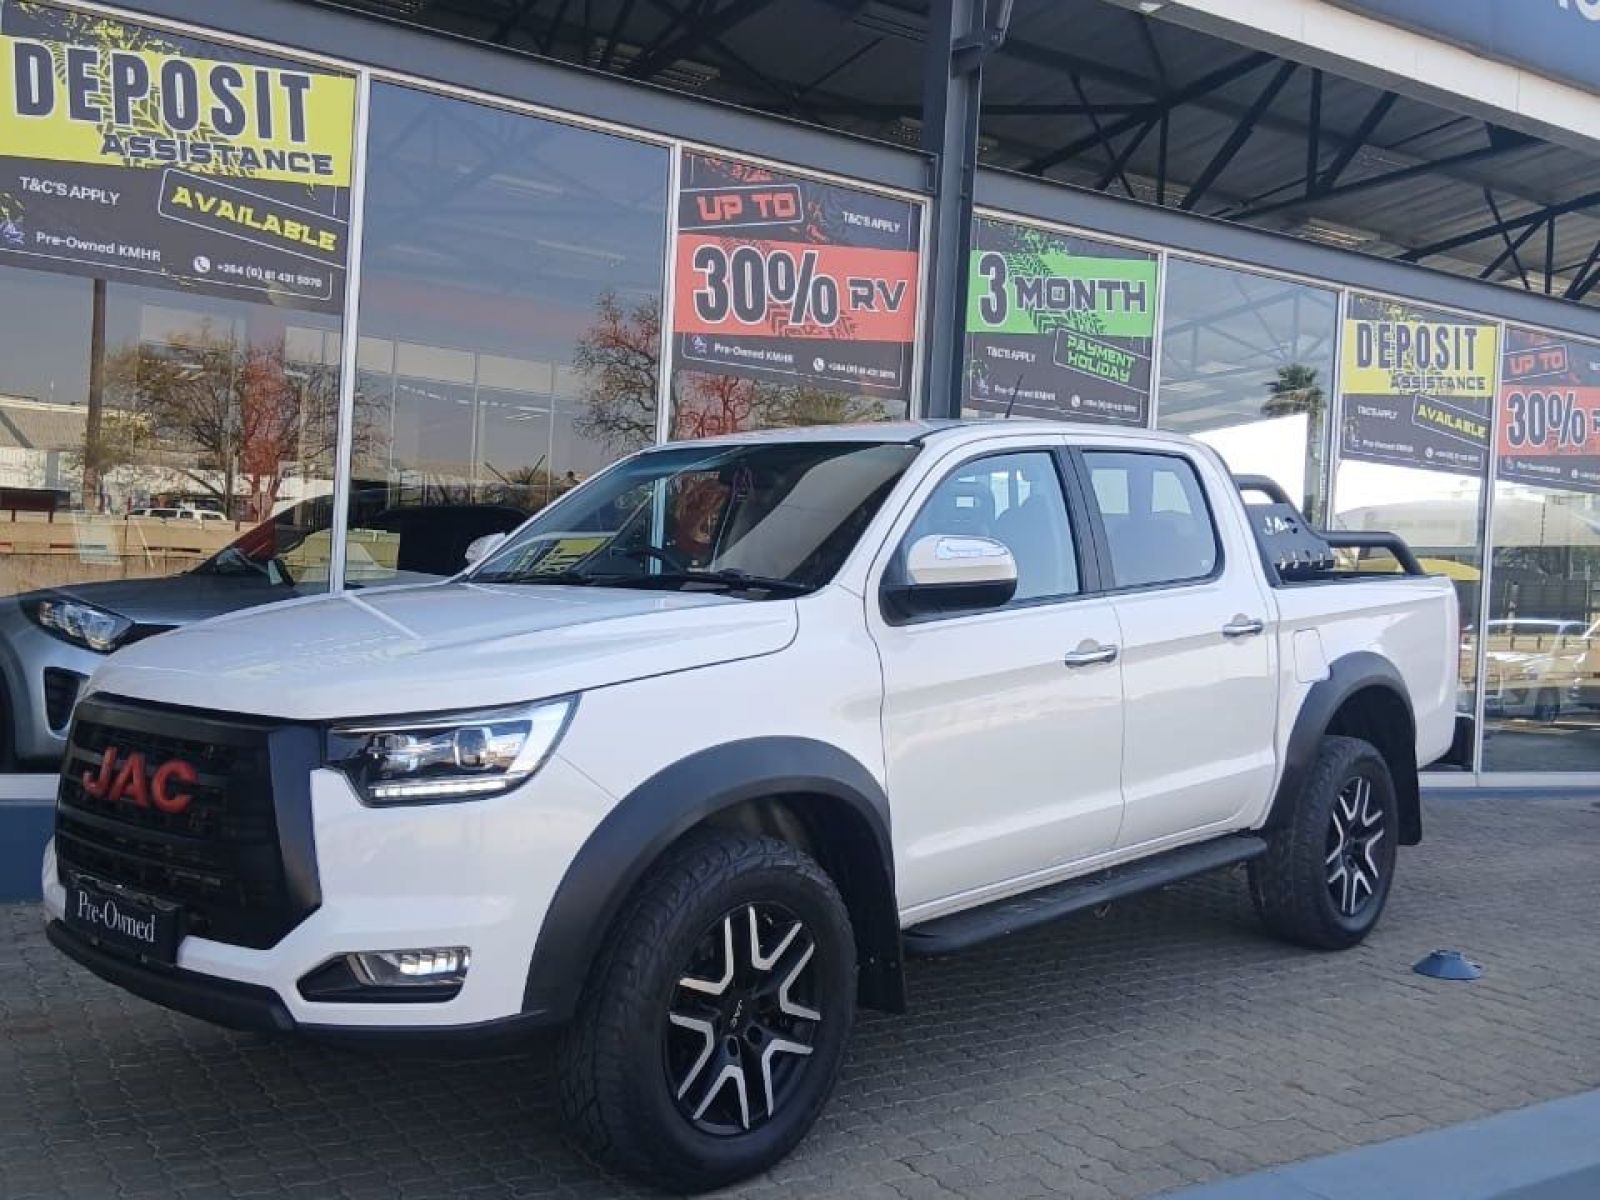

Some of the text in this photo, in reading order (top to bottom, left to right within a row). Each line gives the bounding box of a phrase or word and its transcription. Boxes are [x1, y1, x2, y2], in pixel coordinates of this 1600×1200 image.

[13, 40, 311, 144] DEPOSIT
[101, 133, 334, 176] ASSISTANCE
[19, 177, 120, 207] T&C'S APPLY
[697, 192, 796, 221] UP TO
[171, 186, 337, 252] AVAILABLE
[36, 231, 161, 263] Pre-Owned KMHR
[692, 244, 909, 328] 30% RV
[978, 250, 1148, 328] 3 MONTH
[1067, 334, 1136, 368] PAYMENT
[1067, 350, 1131, 384] HOLIDAY
[1356, 322, 1478, 371] DEPOSIT
[1509, 350, 1562, 374] UP TO
[1390, 374, 1486, 392] ASSISTANCE
[1417, 404, 1487, 439] AVAILABLE
[1506, 391, 1586, 448] 30%
[81, 745, 200, 814] JAC
[76, 890, 156, 944] Pre-Owned
